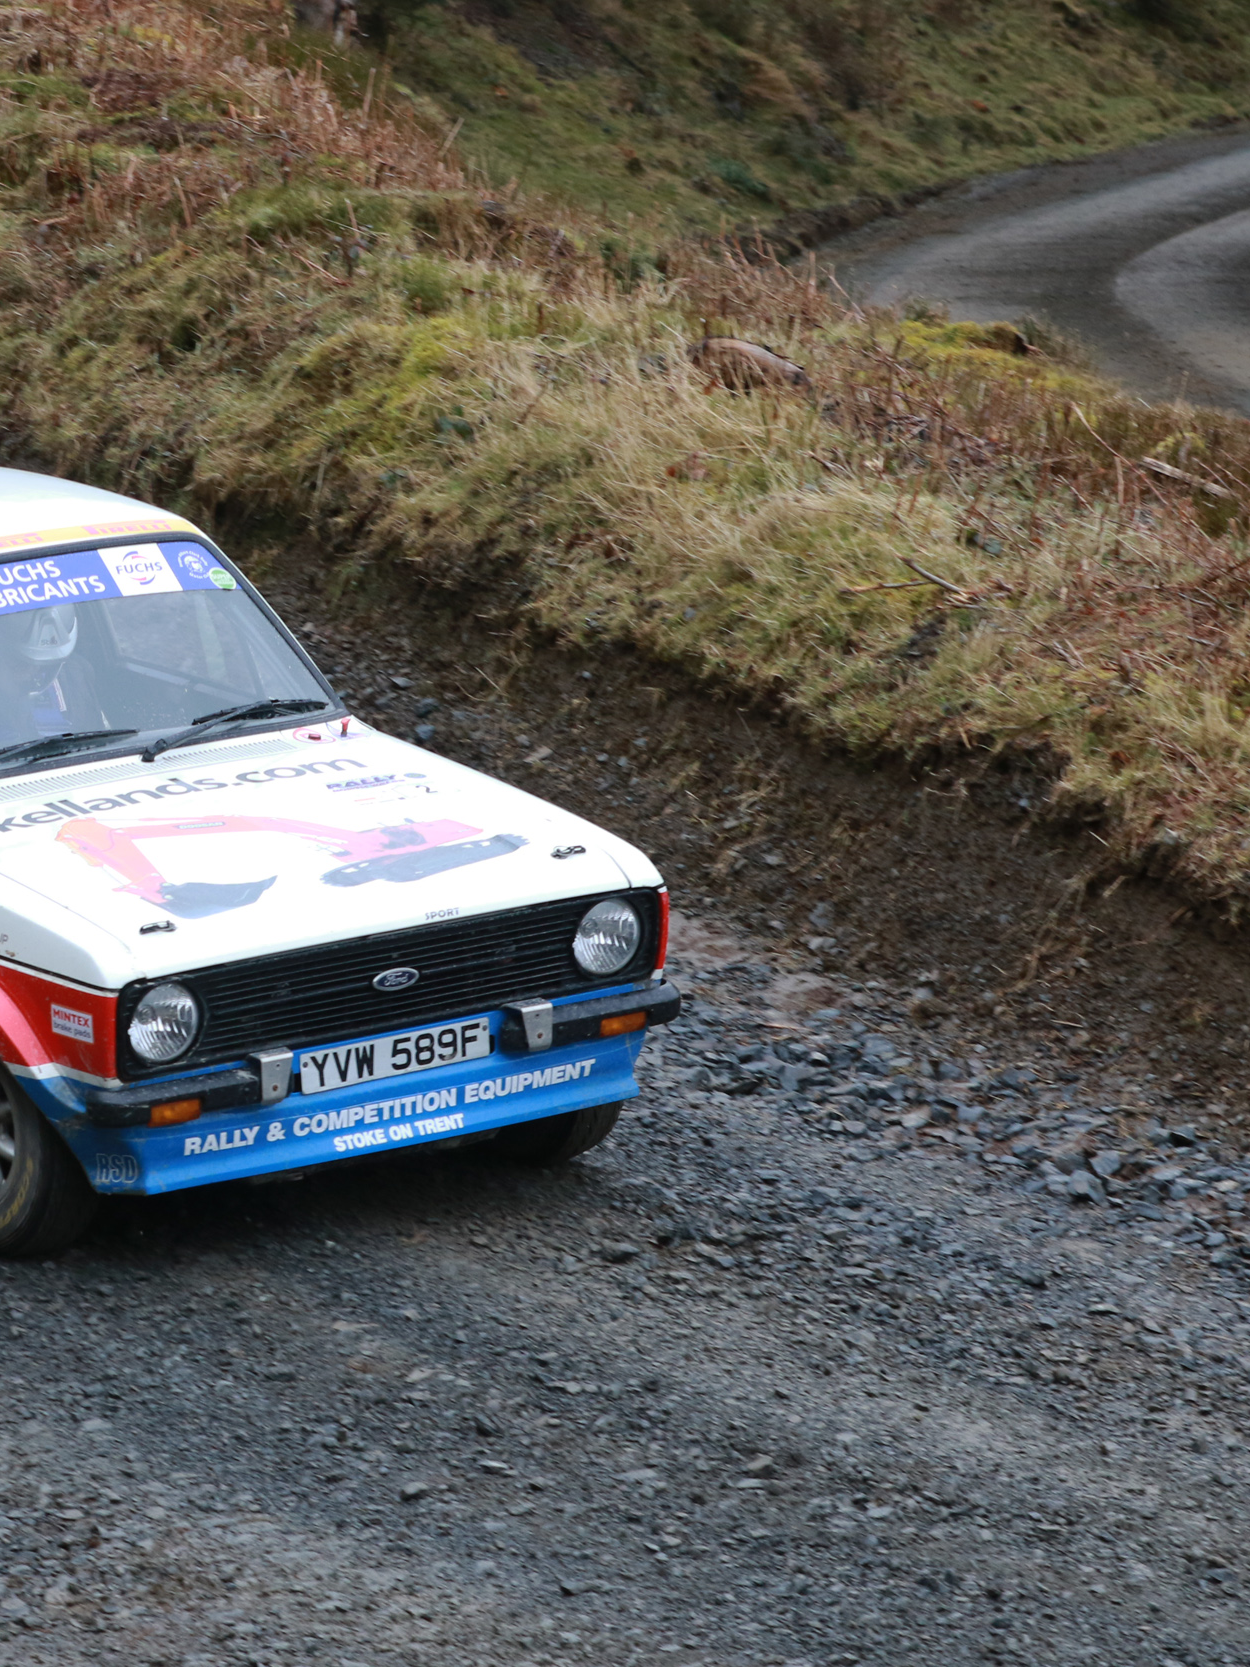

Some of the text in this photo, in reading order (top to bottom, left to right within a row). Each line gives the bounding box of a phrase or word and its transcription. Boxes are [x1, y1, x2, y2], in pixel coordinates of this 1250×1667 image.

[115, 561, 163, 575] FUCHS
[425, 907, 460, 921] SPORT
[53, 1008, 91, 1029] MINTEX
[307, 1023, 482, 1088] YVW 589F
[184, 1057, 598, 1157] RALLY & COMPETITION EQUIPMENT
[333, 1113, 465, 1153] STOKE ON TRENT
[95, 1152, 138, 1184] RSD
